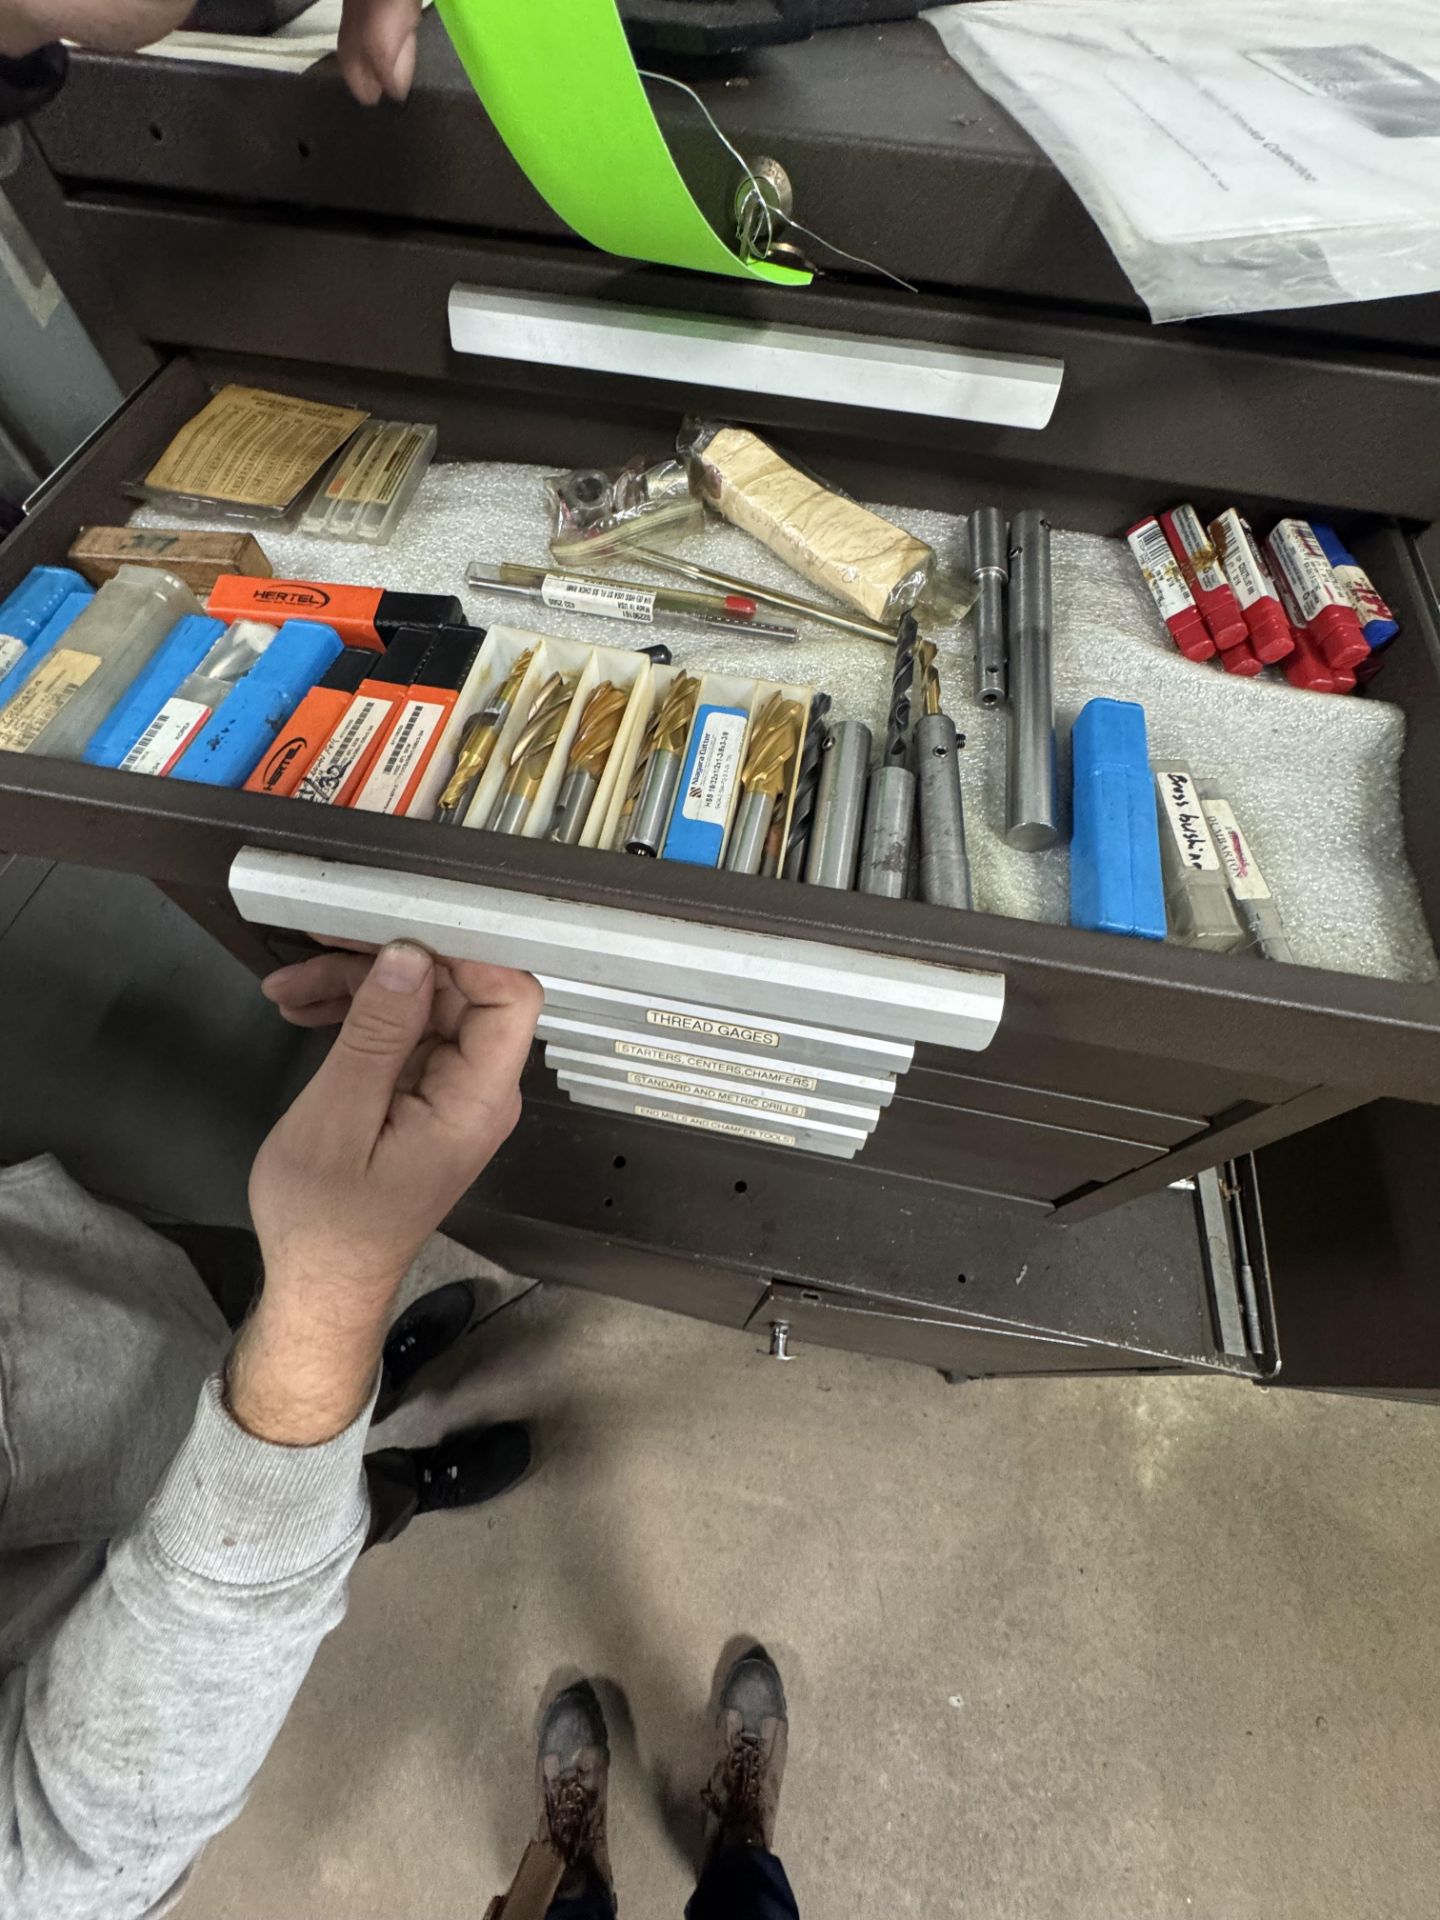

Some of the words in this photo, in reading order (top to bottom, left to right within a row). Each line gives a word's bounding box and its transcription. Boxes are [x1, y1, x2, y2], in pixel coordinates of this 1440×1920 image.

[254, 588, 320, 606] HERTEL
[263, 744, 302, 791] HERTEL
[692, 756, 706, 785] Niagara
[700, 733, 711, 756] Cutter
[1168, 773, 1189, 808] Brass
[1207, 815, 1240, 878] DUMBARTON
[651, 1011, 713, 1033] THREAD
[717, 1025, 774, 1045] GAGES
[621, 1044, 685, 1065] STARTERS,
[633, 1074, 691, 1093] STANDARD
[693, 1088, 716, 1098] AND
[717, 1091, 760, 1106] METRIC
[761, 1100, 799, 1115] DRILLS
[640, 1107, 660, 1117] END
[661, 1111, 688, 1122] MILLS
[689, 1117, 710, 1126] AND
[710, 1120, 758, 1137] CHAMFER
[758, 1129, 790, 1143] TOOLS
